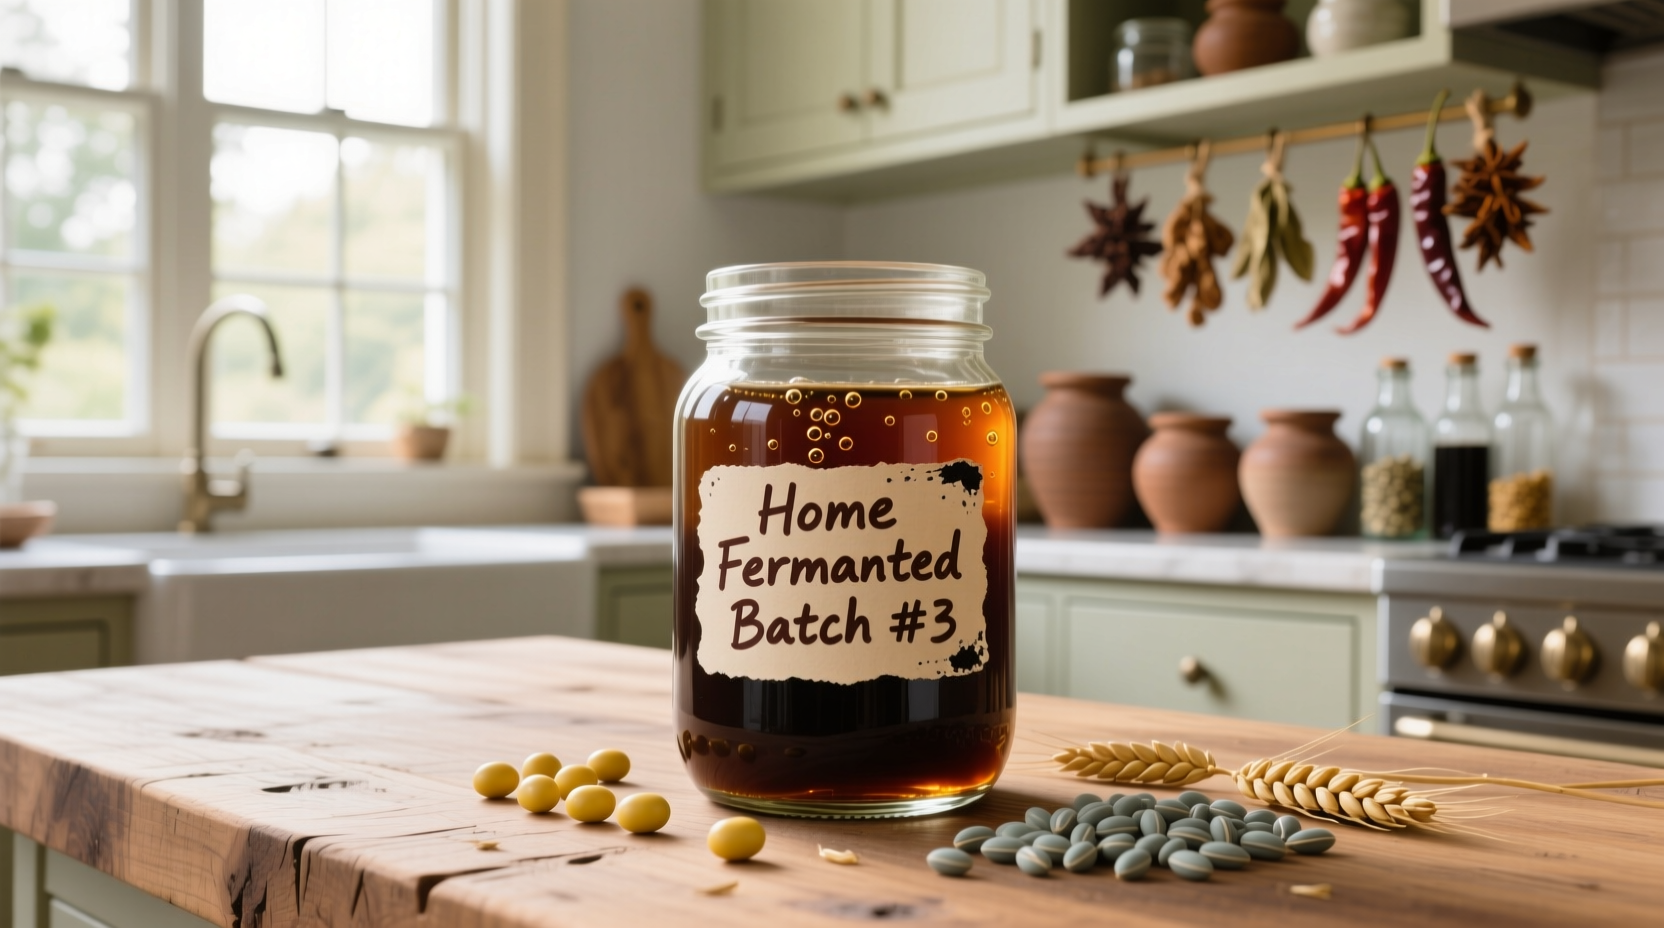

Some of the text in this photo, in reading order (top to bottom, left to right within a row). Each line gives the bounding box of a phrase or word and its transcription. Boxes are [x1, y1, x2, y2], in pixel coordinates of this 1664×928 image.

[758, 482, 897, 536] Home
[718, 528, 962, 591] Fermanted
[730, 596, 957, 650] Batch #3
